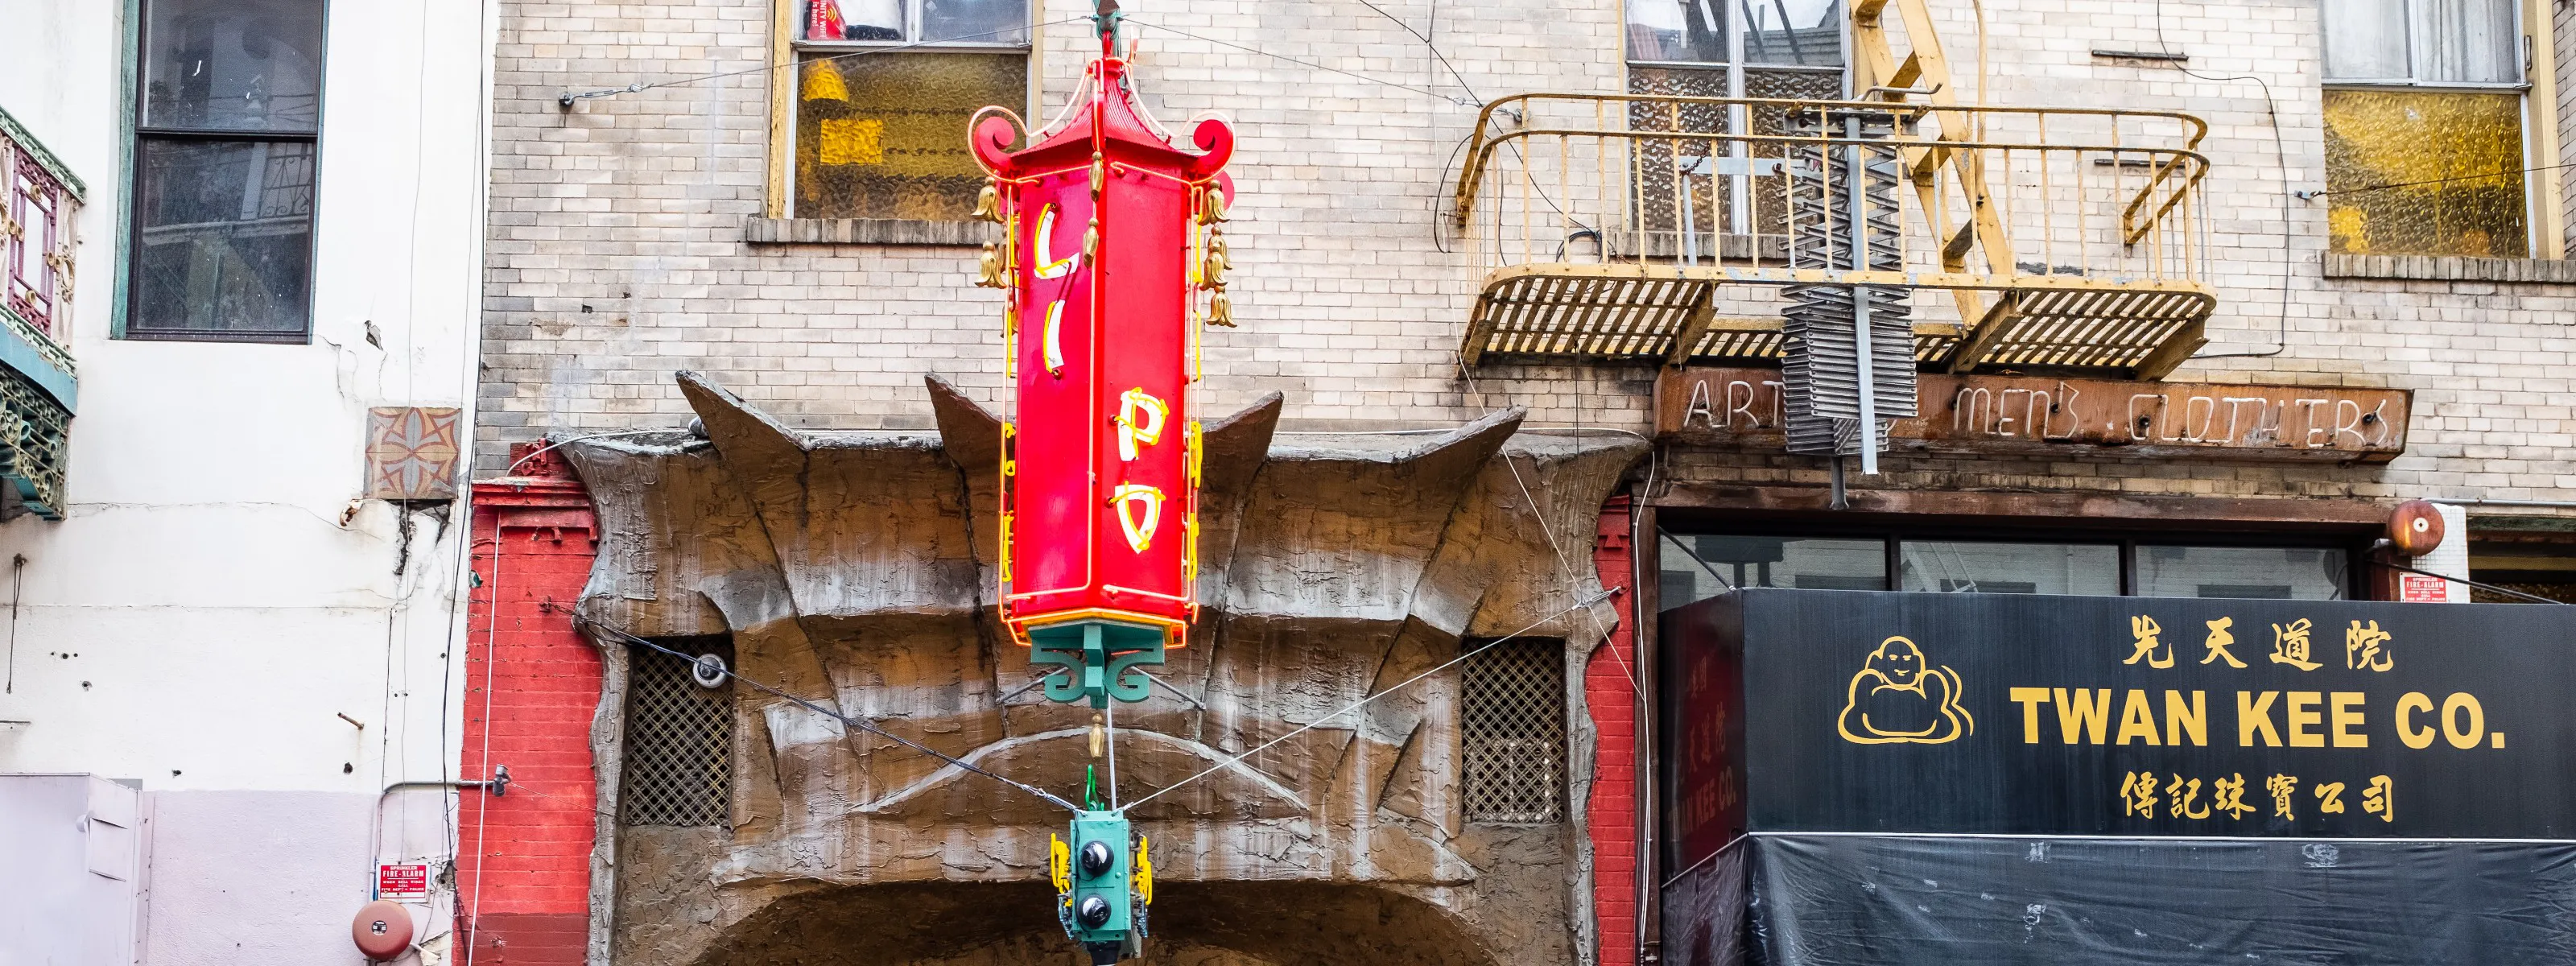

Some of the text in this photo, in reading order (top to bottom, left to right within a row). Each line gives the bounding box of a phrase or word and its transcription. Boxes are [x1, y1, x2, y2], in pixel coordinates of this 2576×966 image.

[811, 9, 819, 27] here!
[1034, 202, 1080, 374] LI
[2129, 394, 2388, 448] CLOTHERS
[2123, 614, 2395, 672] 先天道院
[2009, 687, 2505, 749] TWAN KEE CO.
